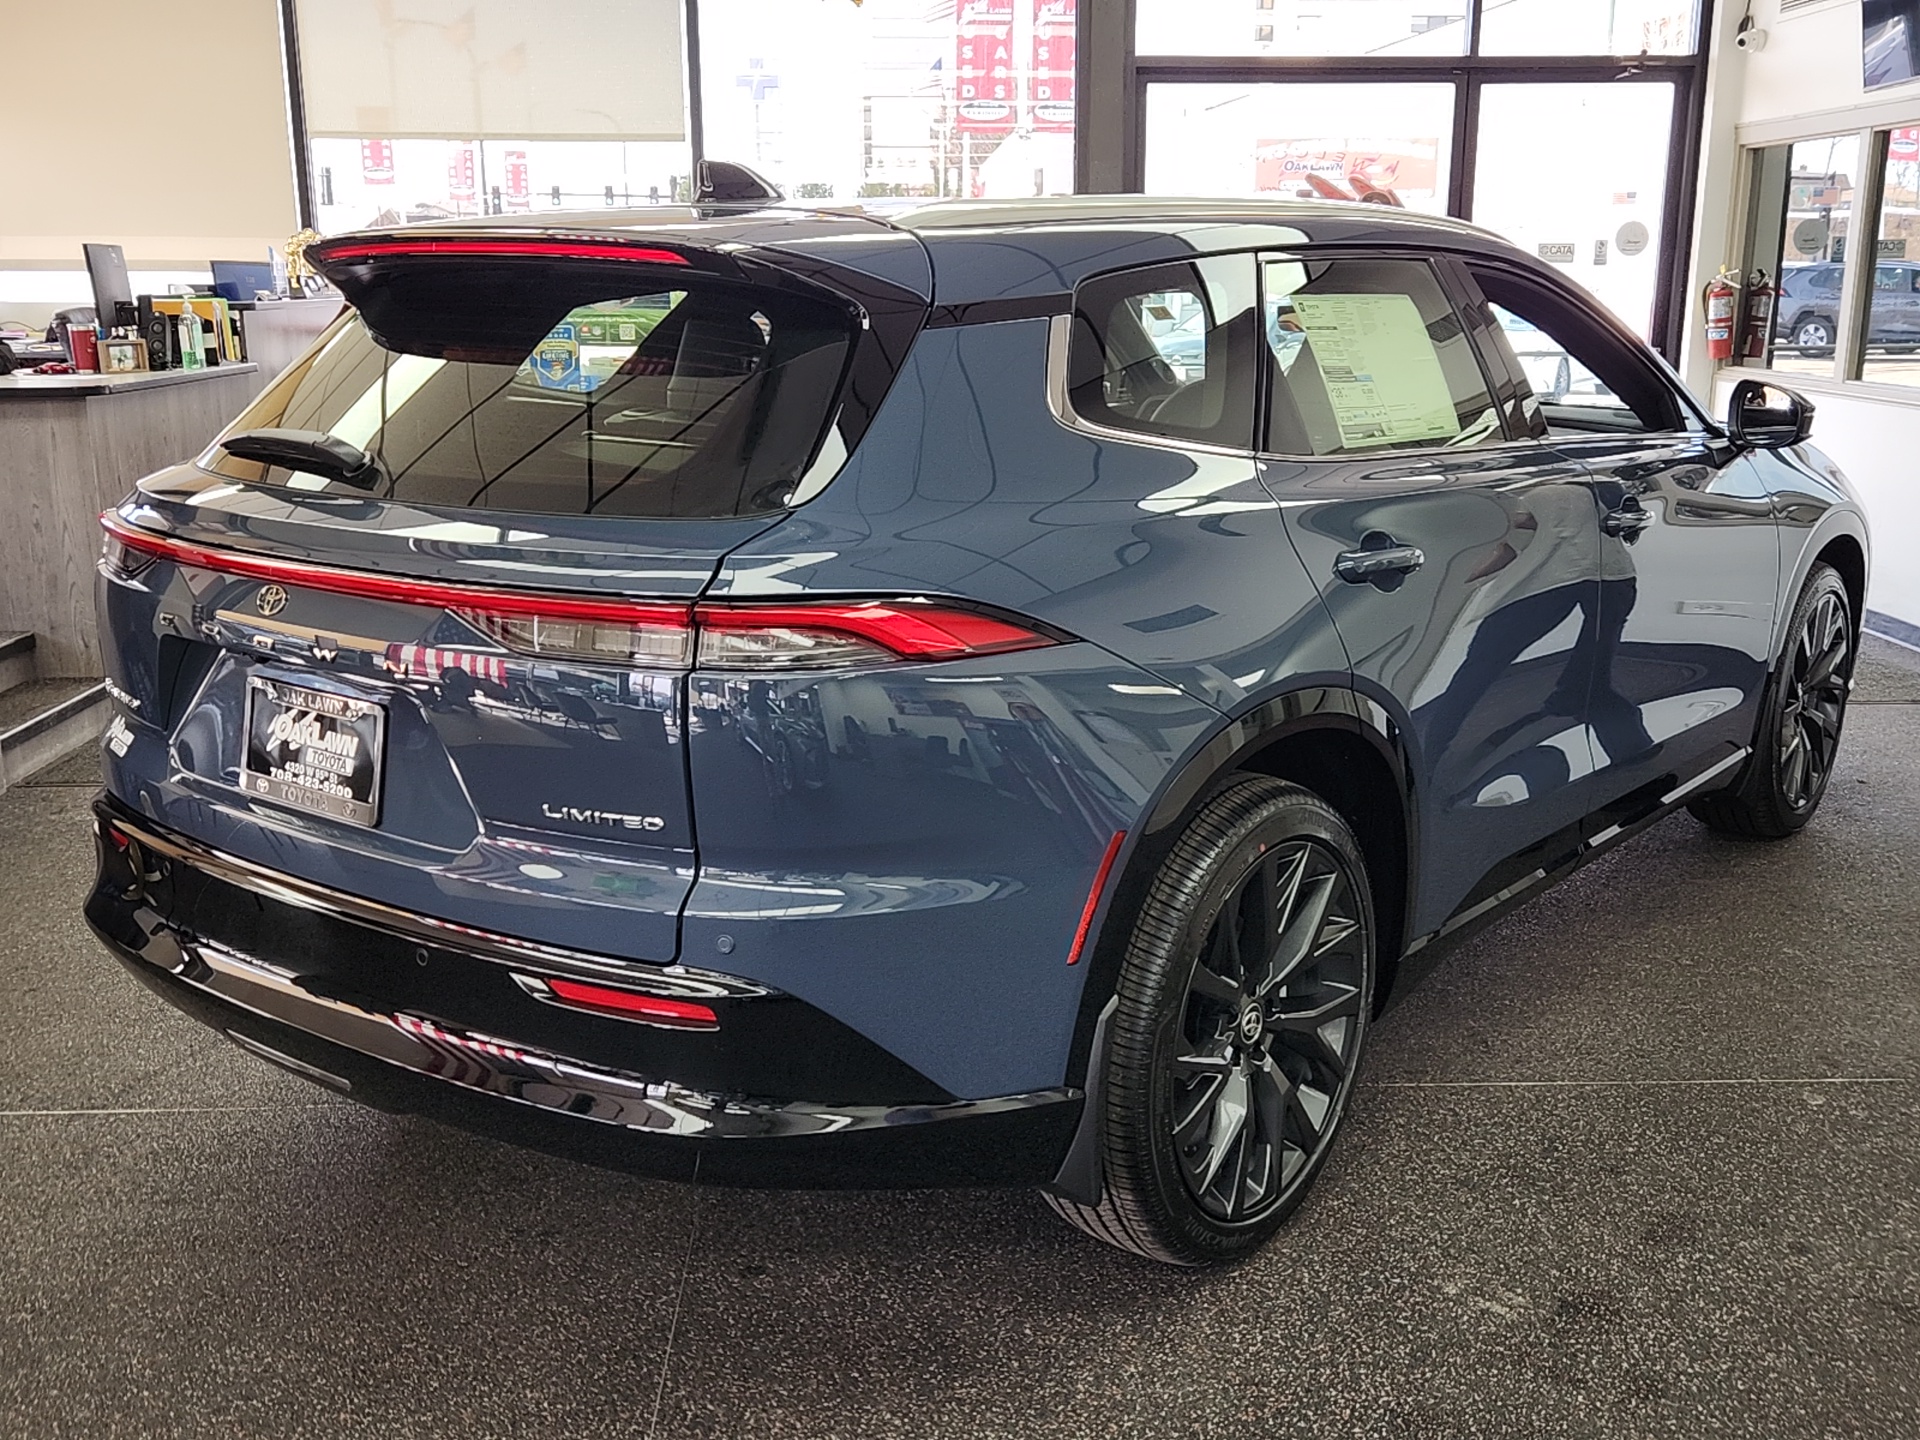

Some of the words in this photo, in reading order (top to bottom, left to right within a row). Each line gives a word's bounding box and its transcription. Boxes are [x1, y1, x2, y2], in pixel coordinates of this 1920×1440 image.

[1549, 245, 1573, 255] CATA
[282, 688, 307, 706] OAK
[308, 694, 345, 715] LAWN
[284, 761, 304, 775] 4320
[305, 766, 315, 776] W
[312, 751, 348, 772] TOYOTA
[270, 767, 353, 799] 708-423-5200
[280, 785, 329, 811] TOYOTA
[541, 803, 665, 831] LIMITED
